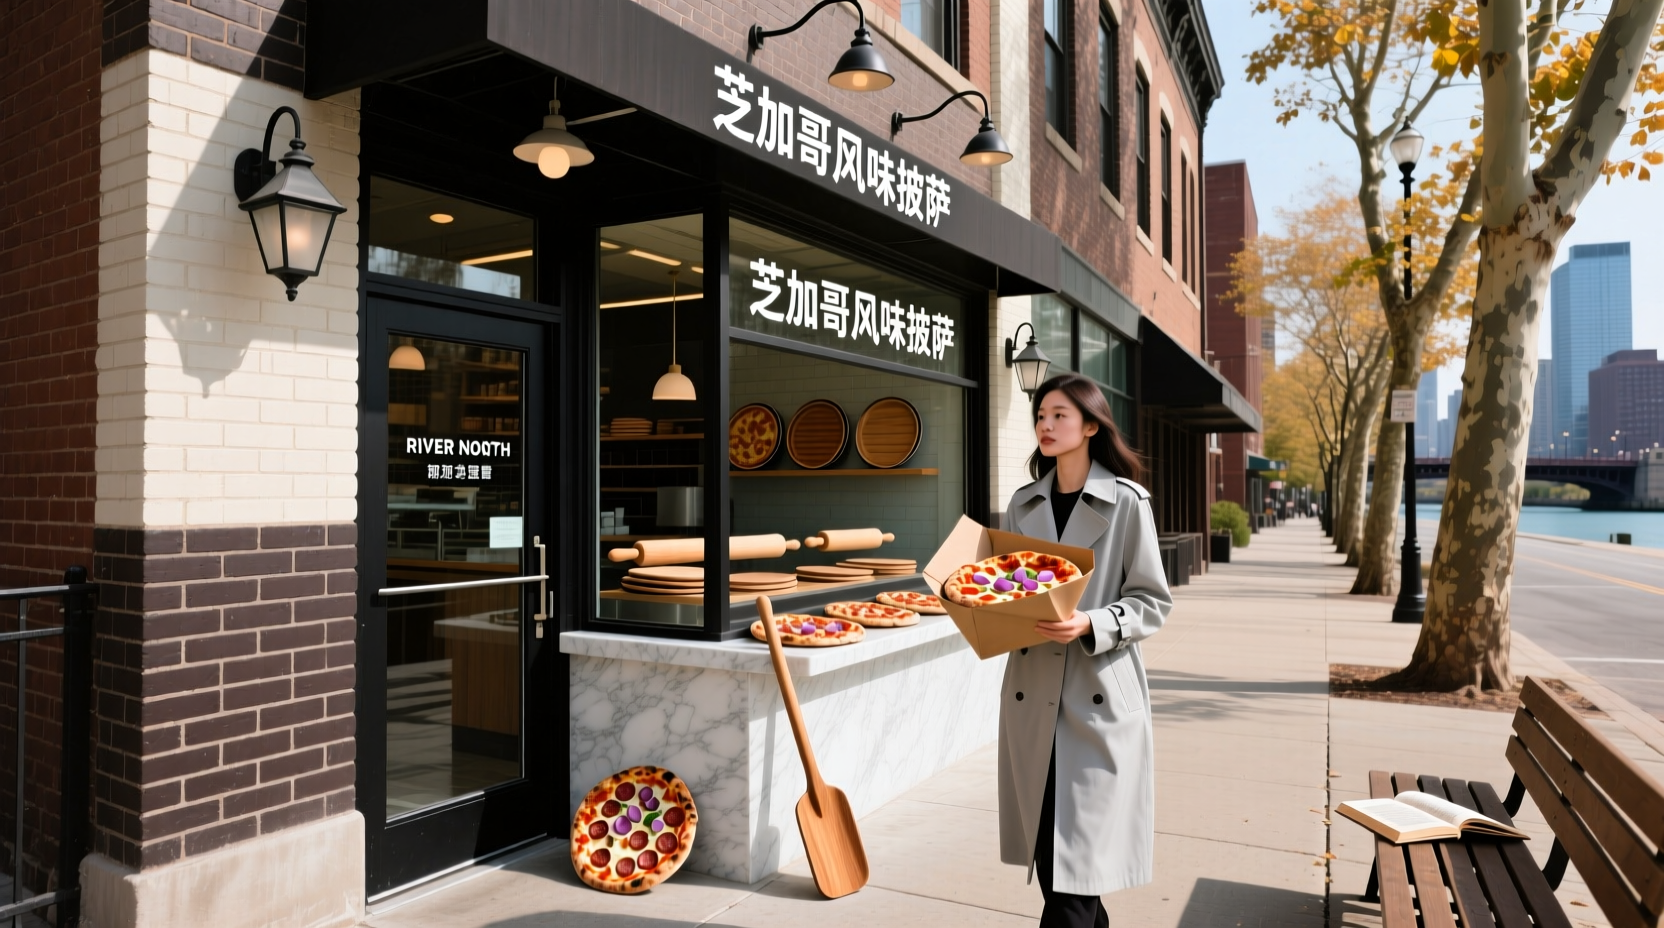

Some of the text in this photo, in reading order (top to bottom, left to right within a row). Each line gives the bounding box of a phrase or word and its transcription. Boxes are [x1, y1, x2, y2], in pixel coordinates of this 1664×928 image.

[713, 64, 951, 228] 芝加哥风味披萨
[749, 257, 955, 361] 芝加哥风味披萨
[406, 437, 454, 455] RIVER
